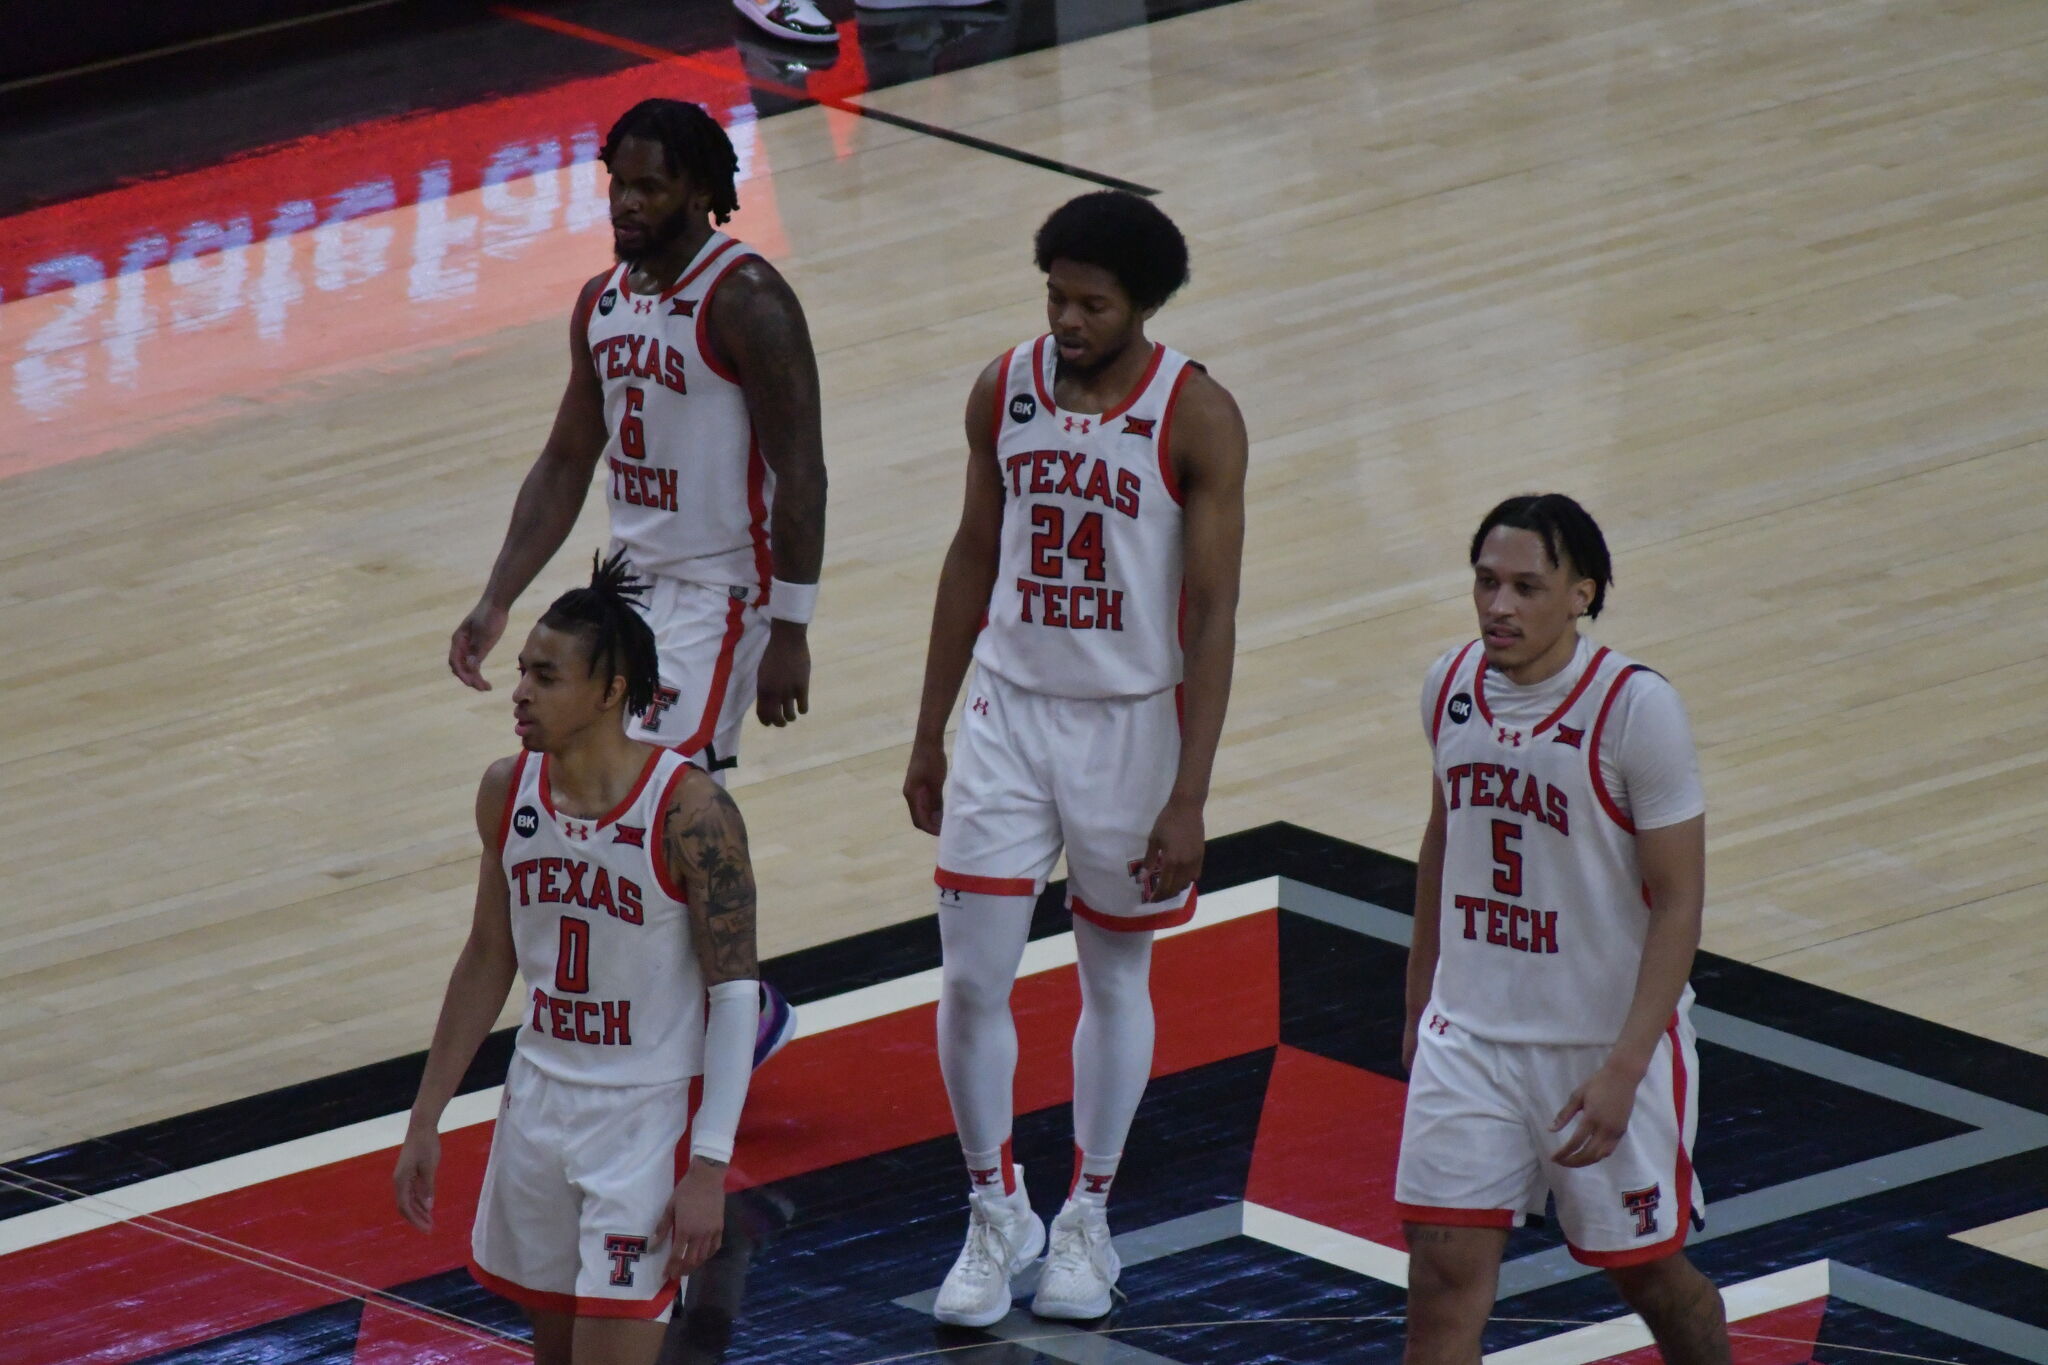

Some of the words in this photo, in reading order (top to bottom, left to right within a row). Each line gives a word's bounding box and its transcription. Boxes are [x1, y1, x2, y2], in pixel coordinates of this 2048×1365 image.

[592, 333, 687, 395] TEXAS
[620, 386, 646, 460] 6
[1012, 401, 1033, 415] BK
[610, 456, 679, 512] TECH
[1006, 450, 1141, 519] TEXAS
[1031, 503, 1106, 582] 24
[1017, 577, 1124, 631] TECH
[1451, 700, 1471, 716] BK
[517, 815, 536, 829] BK
[1446, 762, 1569, 837] TEXAS
[1491, 818, 1523, 897] 5
[511, 857, 644, 926] TEXAS
[555, 915, 590, 993] 0
[1454, 894, 1559, 953] TECH
[532, 986, 632, 1046] TECH
